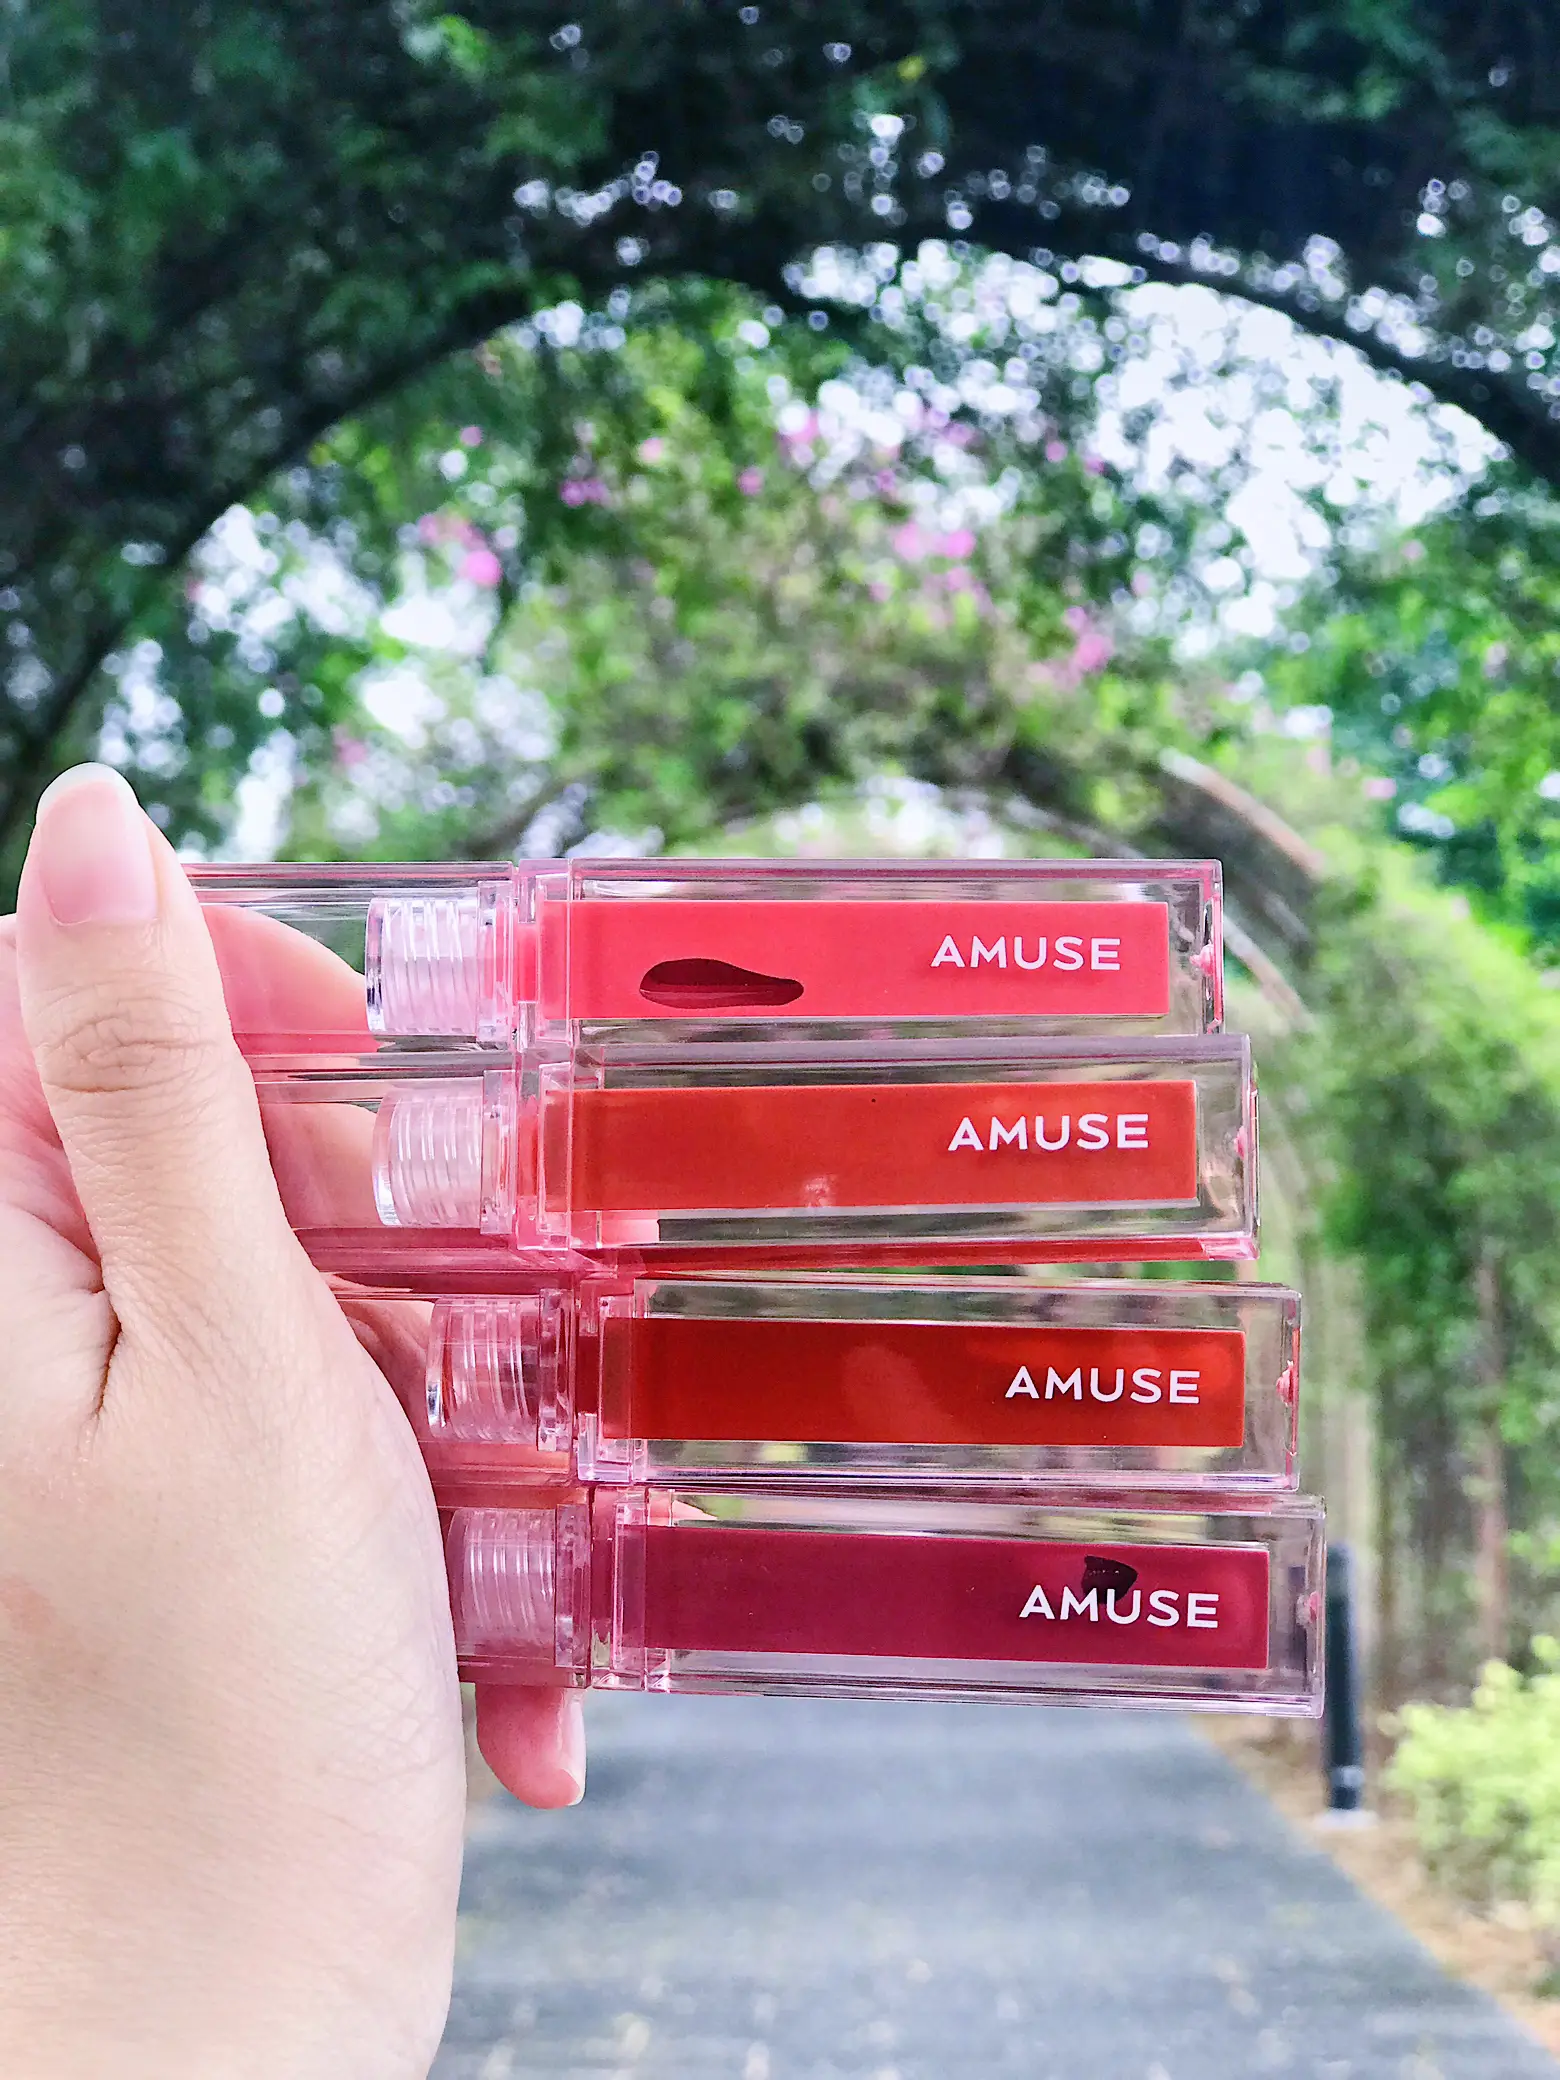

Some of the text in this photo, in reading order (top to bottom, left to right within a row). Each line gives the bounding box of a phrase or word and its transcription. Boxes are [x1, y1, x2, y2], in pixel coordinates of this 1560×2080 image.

[930, 935, 1121, 971] AMUSE
[947, 1113, 1149, 1151] AMUSE
[1005, 1366, 1200, 1404] AMUSE
[1019, 1584, 1219, 1628] AMUSE
